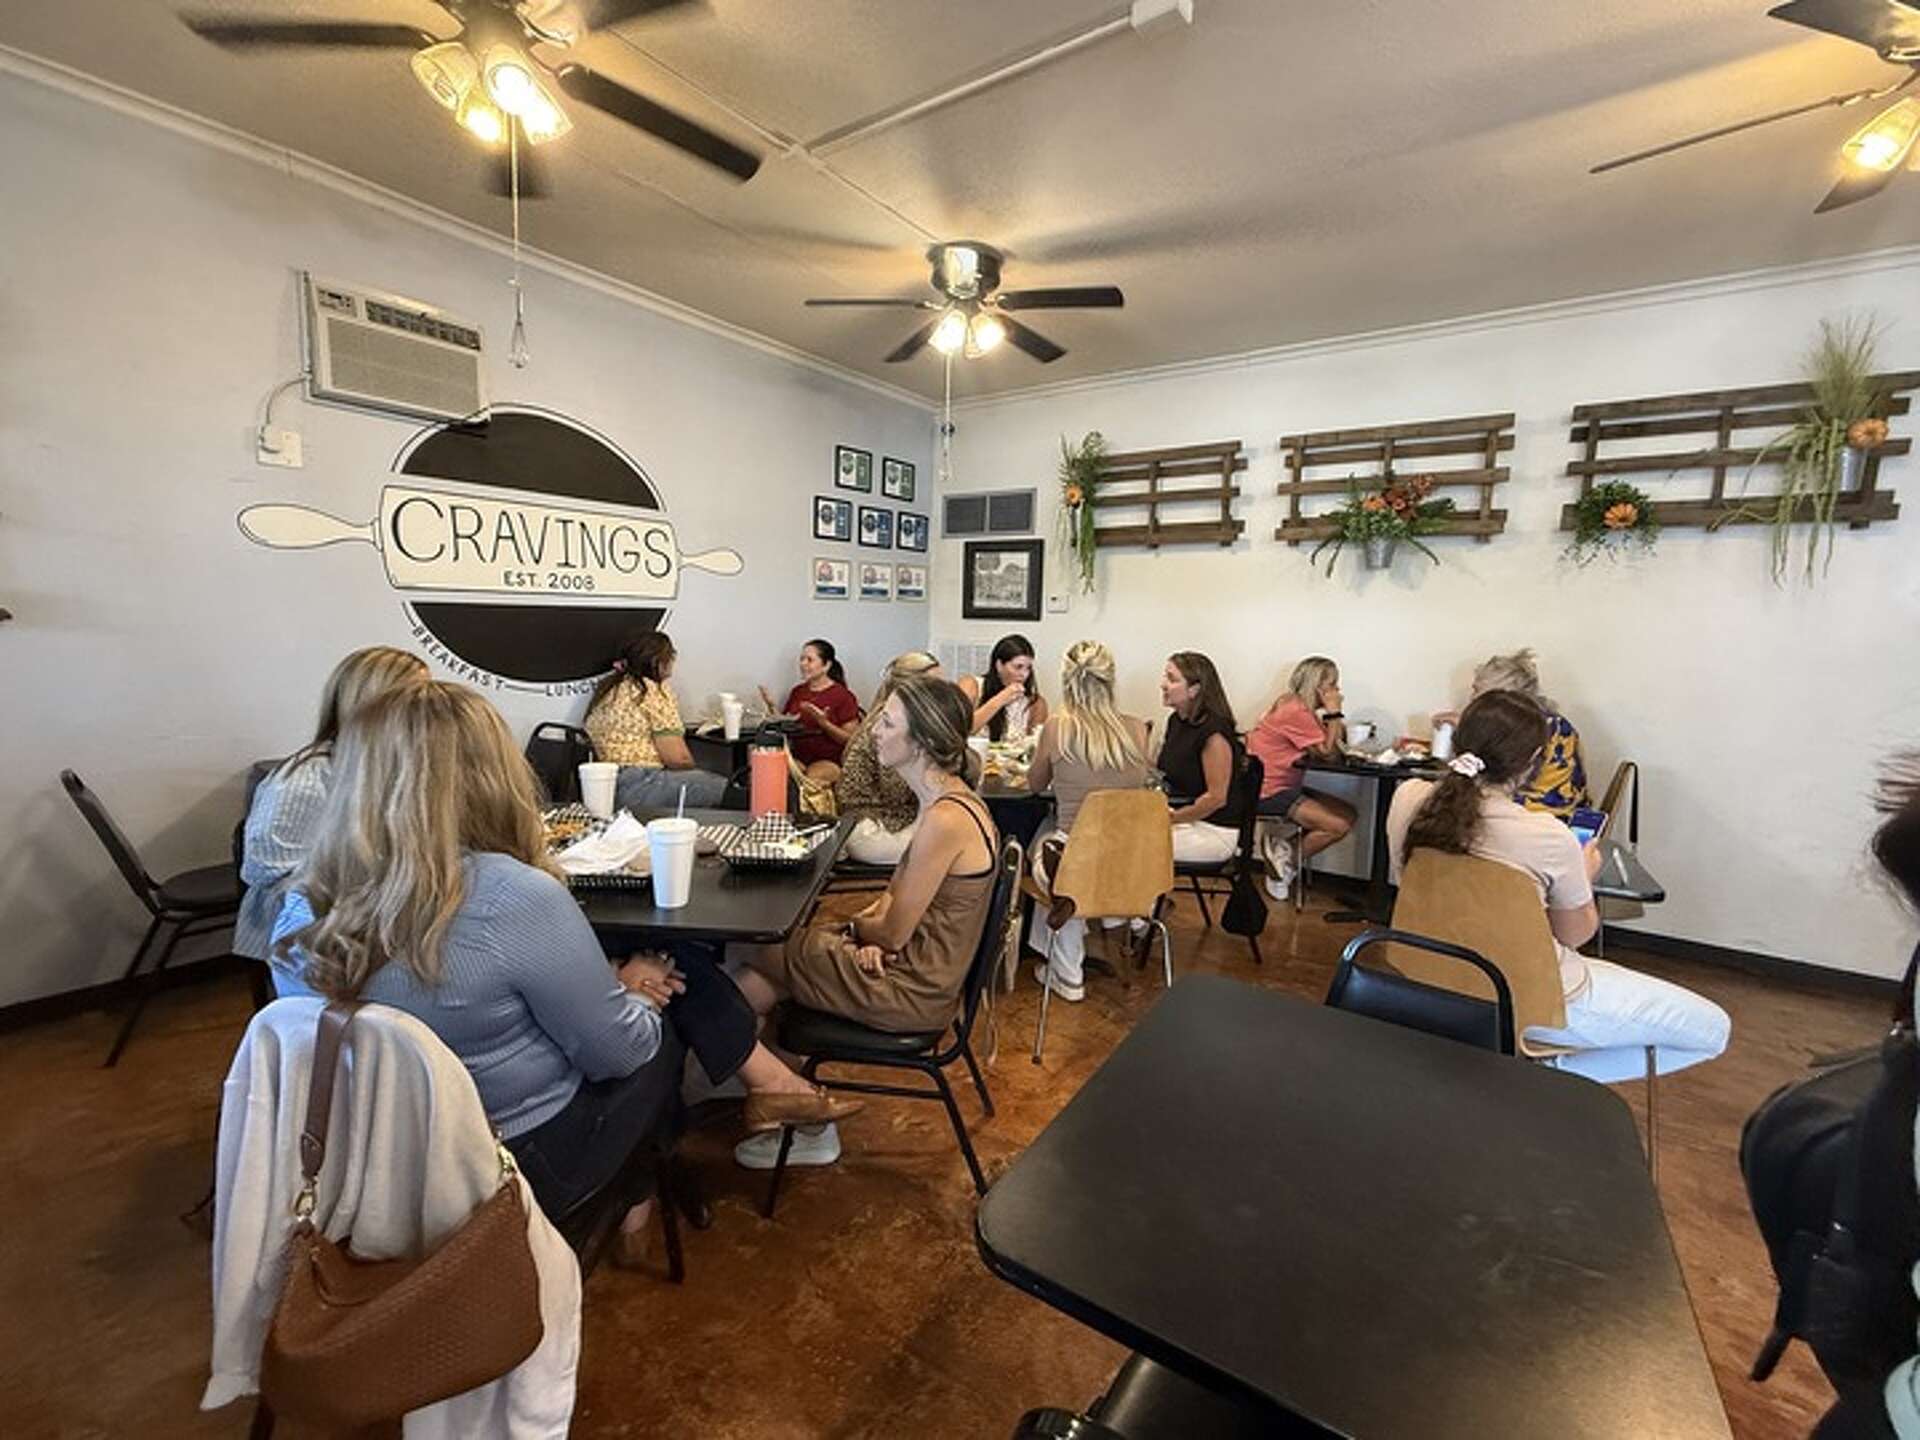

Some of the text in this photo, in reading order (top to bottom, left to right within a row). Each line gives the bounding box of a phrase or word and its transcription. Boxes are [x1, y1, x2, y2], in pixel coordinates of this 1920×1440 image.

[391, 497, 672, 578] CRAVINGS
[503, 570, 542, 587] EST.
[412, 625, 505, 691] BREAKFAST
